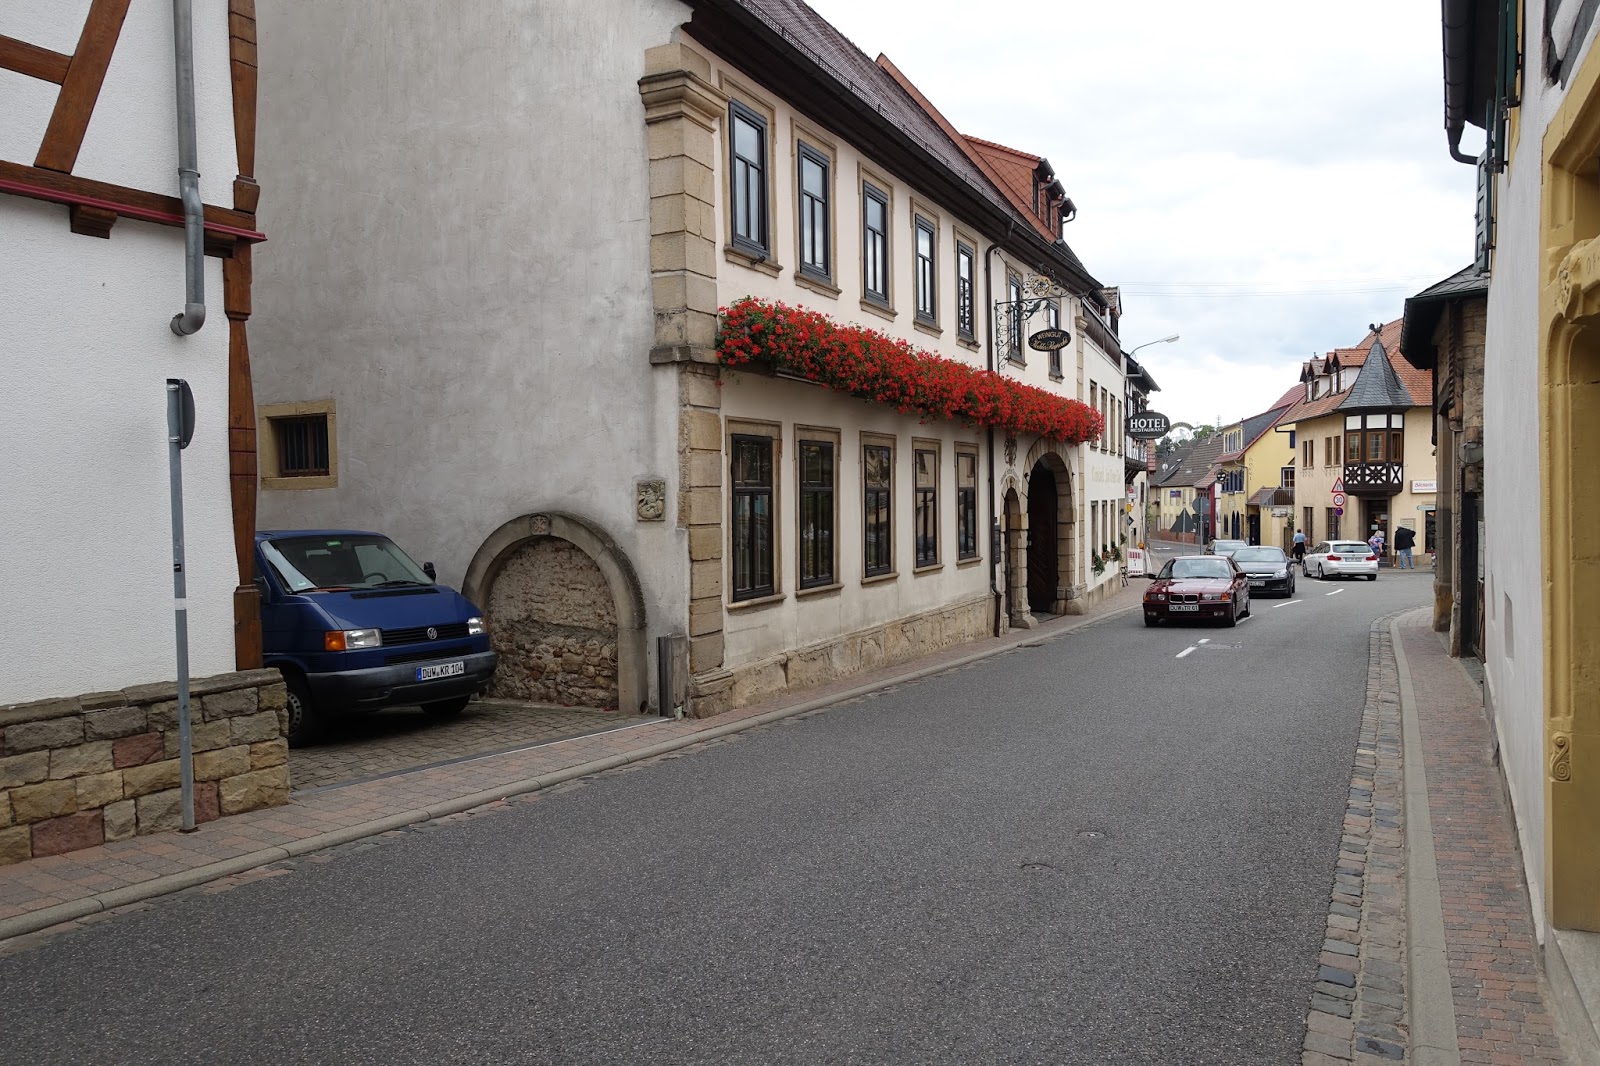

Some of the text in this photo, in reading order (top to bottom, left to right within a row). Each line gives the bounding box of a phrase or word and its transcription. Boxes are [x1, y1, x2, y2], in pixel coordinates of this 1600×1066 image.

[1036, 331, 1063, 340] WEINGUT
[1130, 418, 1166, 428] HOTEL
[451, 663, 463, 674] 104
